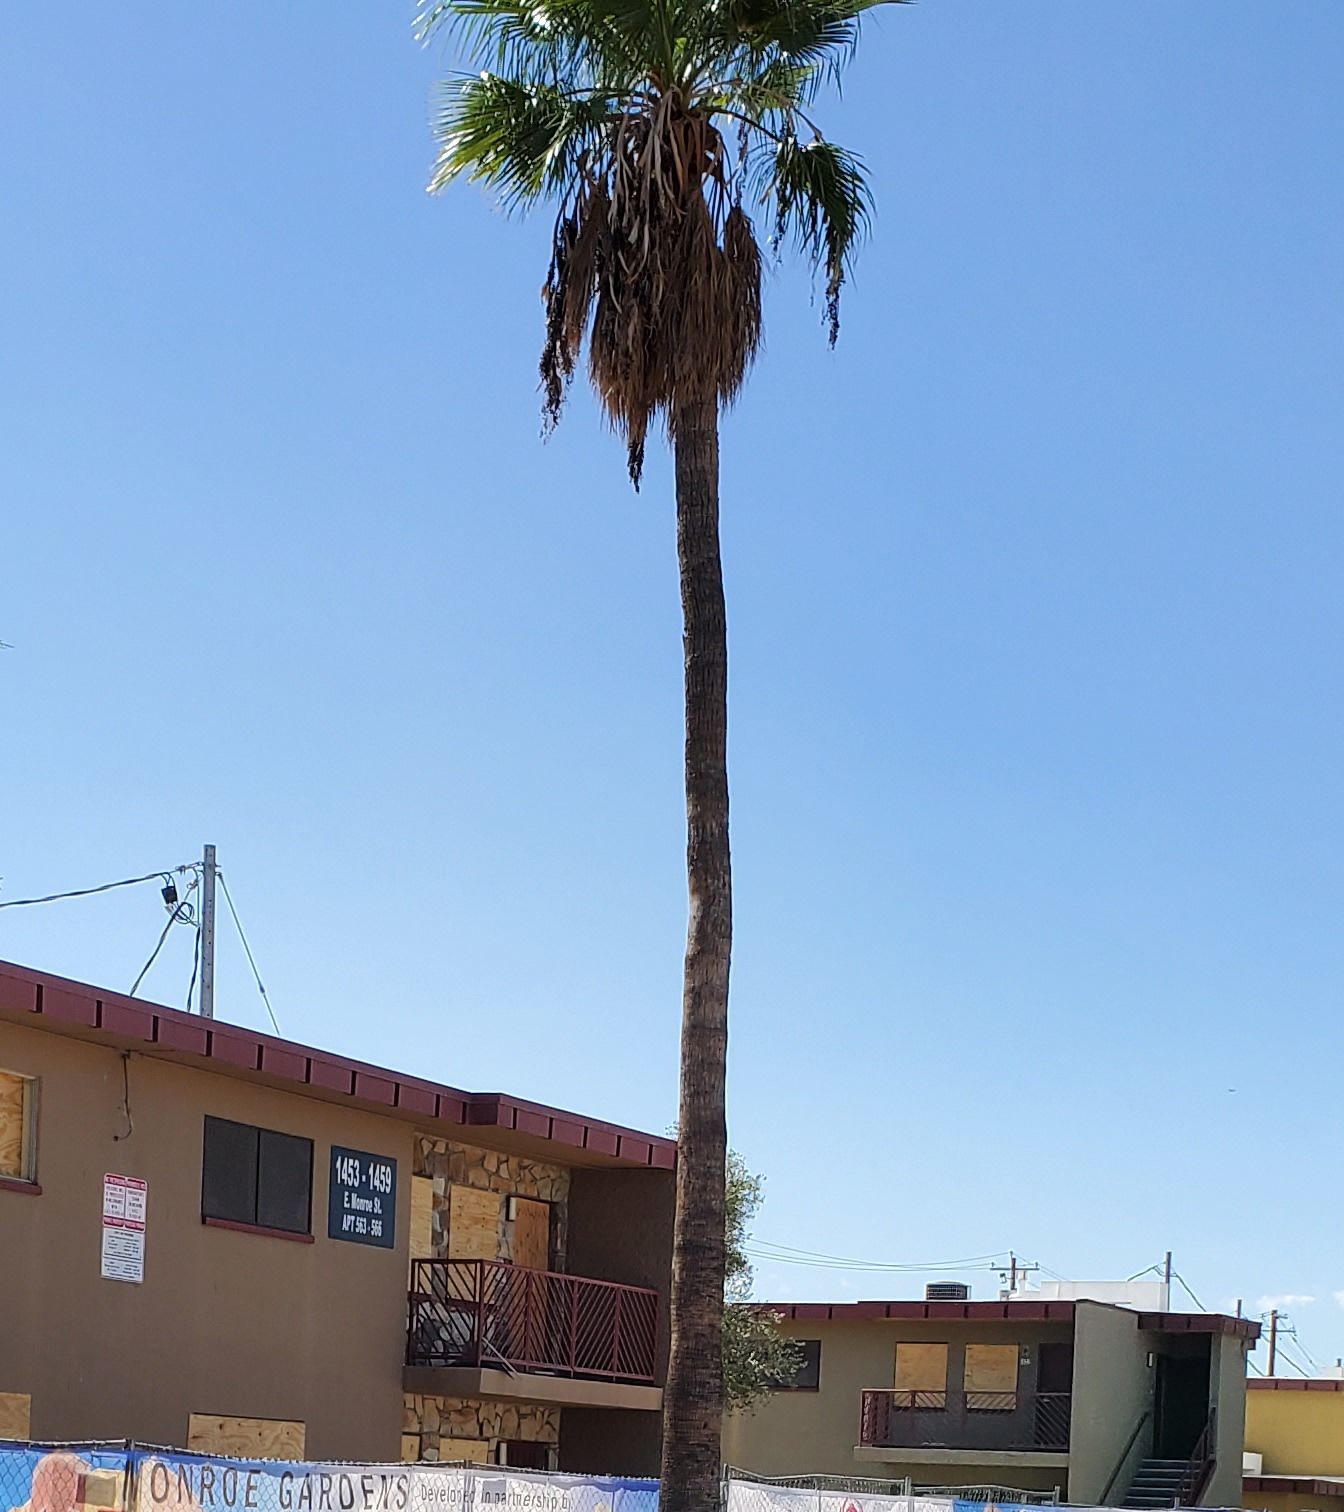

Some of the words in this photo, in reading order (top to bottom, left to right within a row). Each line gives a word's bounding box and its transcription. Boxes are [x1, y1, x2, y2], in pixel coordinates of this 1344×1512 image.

[336, 1155, 360, 1188] 1453
[368, 1162, 391, 1194] 1459
[351, 1192, 373, 1213] Monroe
[373, 1197, 382, 1215] St.
[342, 1214, 355, 1233] APT
[280, 1471, 410, 1510] GARDENS
